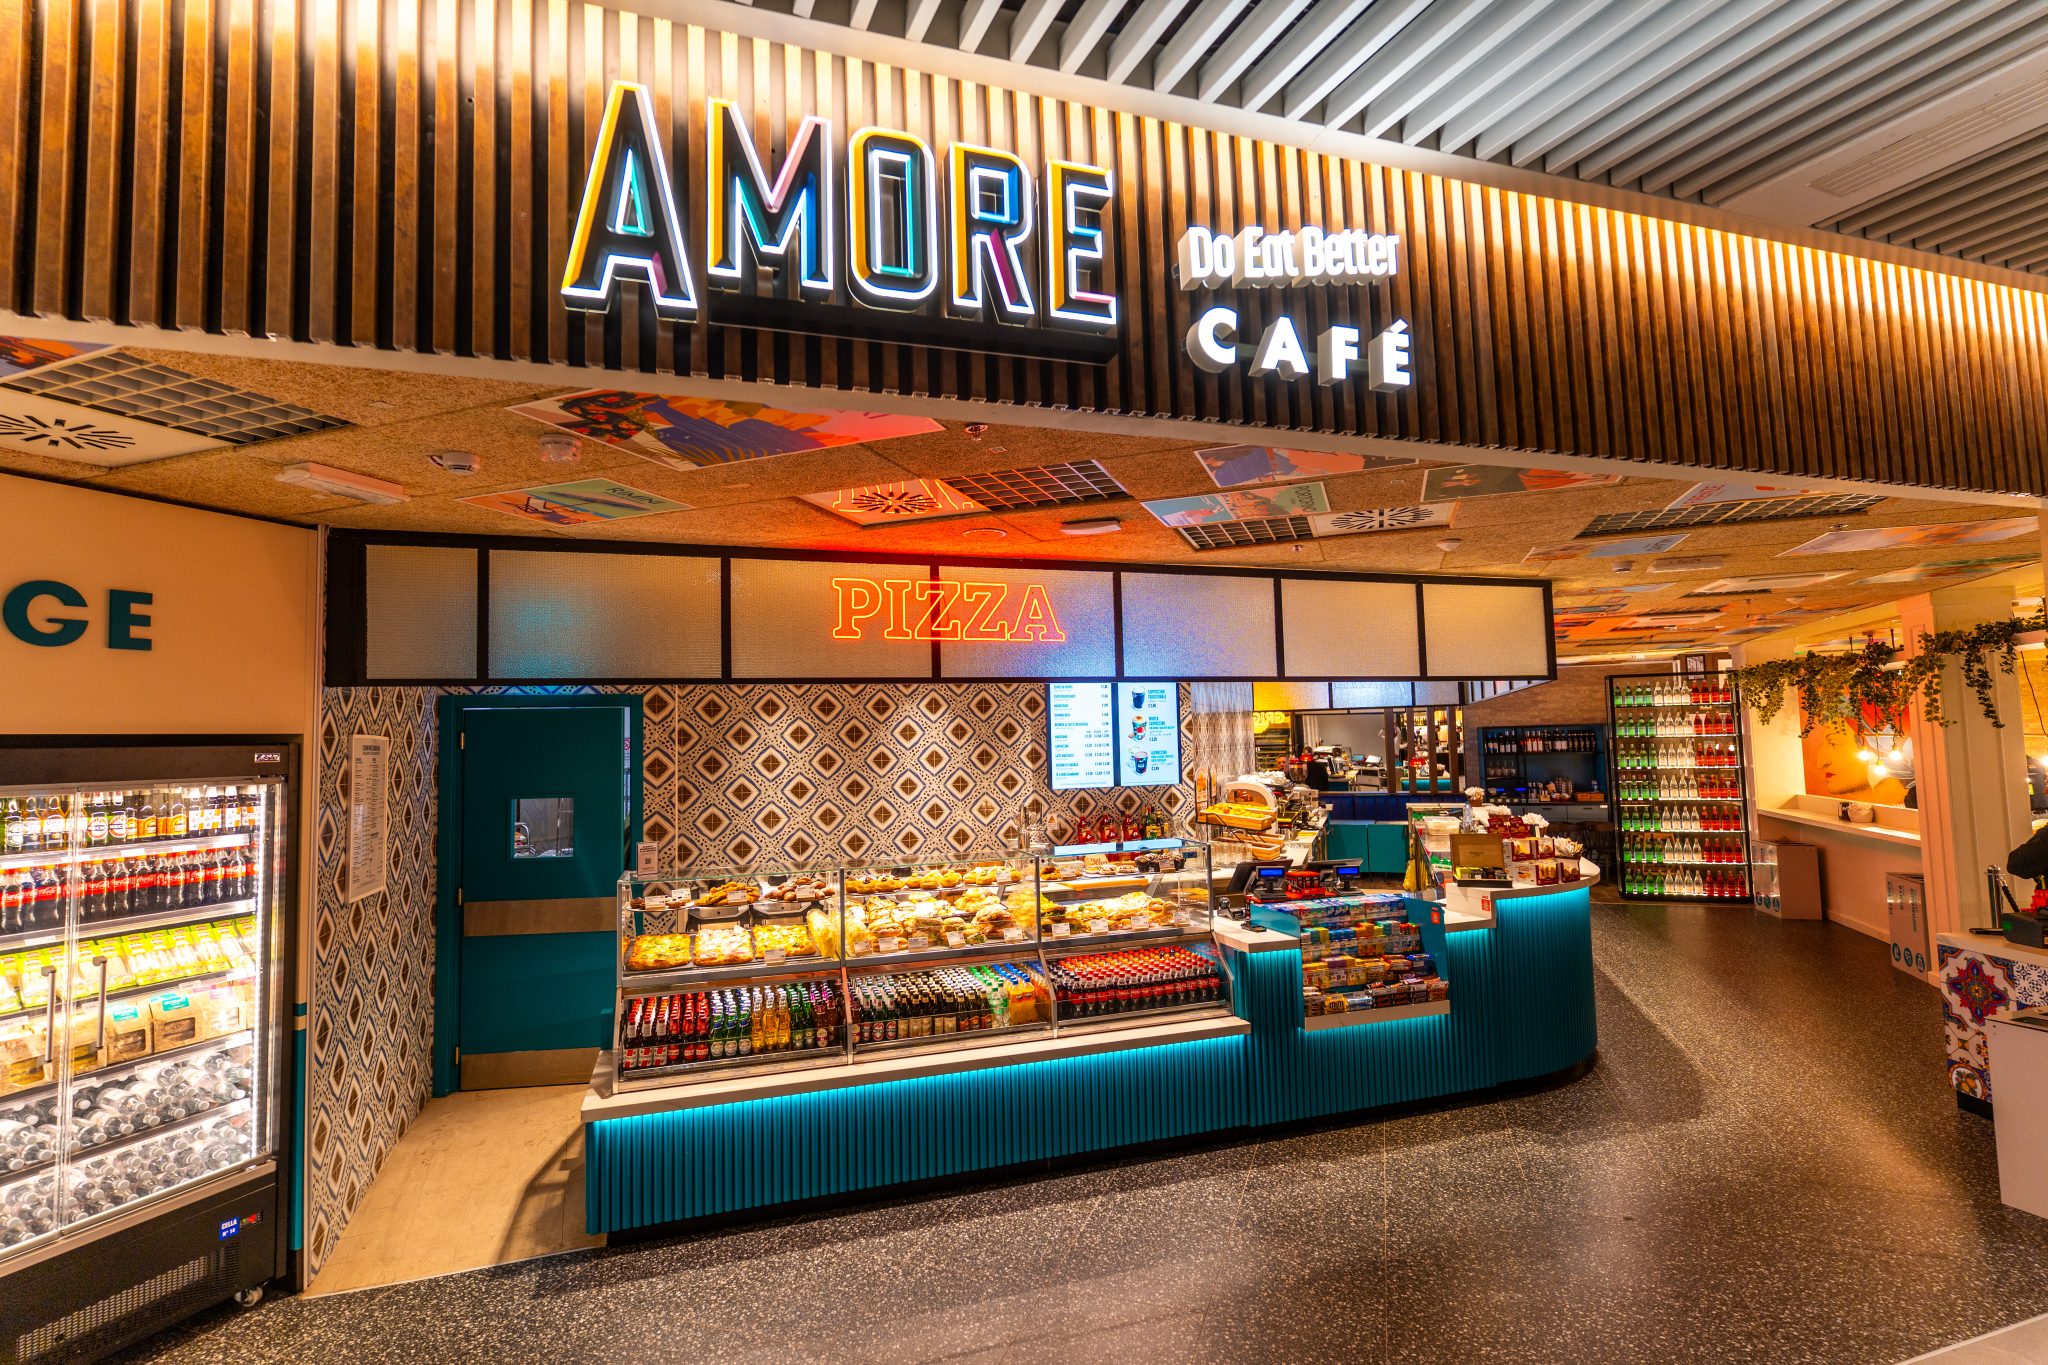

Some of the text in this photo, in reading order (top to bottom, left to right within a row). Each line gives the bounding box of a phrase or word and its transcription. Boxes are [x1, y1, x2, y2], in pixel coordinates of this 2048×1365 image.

[561, 80, 1117, 326] AMORE
[1187, 226, 1399, 278] Do Eat Better
[1197, 306, 1411, 387] CAFÉ
[832, 577, 1067, 642] PIZZA
[221, 1218, 238, 1230] CELLA
